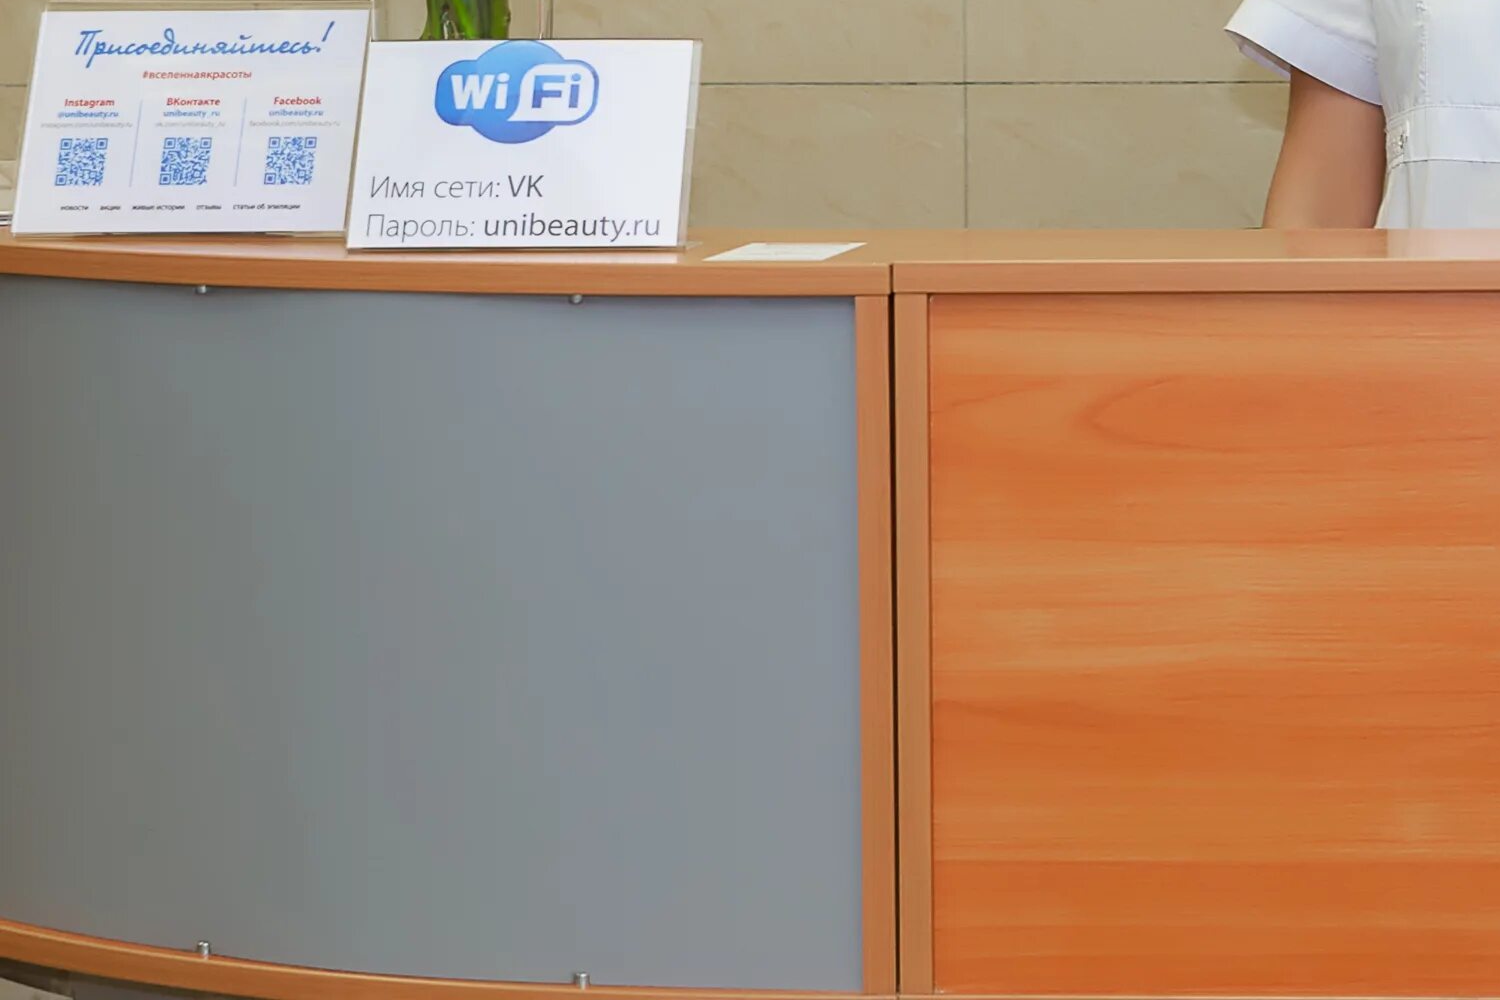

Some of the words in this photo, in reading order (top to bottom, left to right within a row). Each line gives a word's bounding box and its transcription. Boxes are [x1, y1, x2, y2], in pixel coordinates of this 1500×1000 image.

[74, 21, 335, 69] Присоединяйтесь!
[143, 69, 253, 81] #вселеннаякрасоты
[64, 98, 115, 109] Instagram
[166, 97, 220, 107] ВКонтакте
[273, 96, 322, 106] Facebook
[370, 176, 425, 199] Имя
[434, 180, 500, 199] сети:
[508, 174, 545, 198] VK
[366, 214, 475, 242] Пароль:
[484, 212, 661, 242] unibeauty.ru
